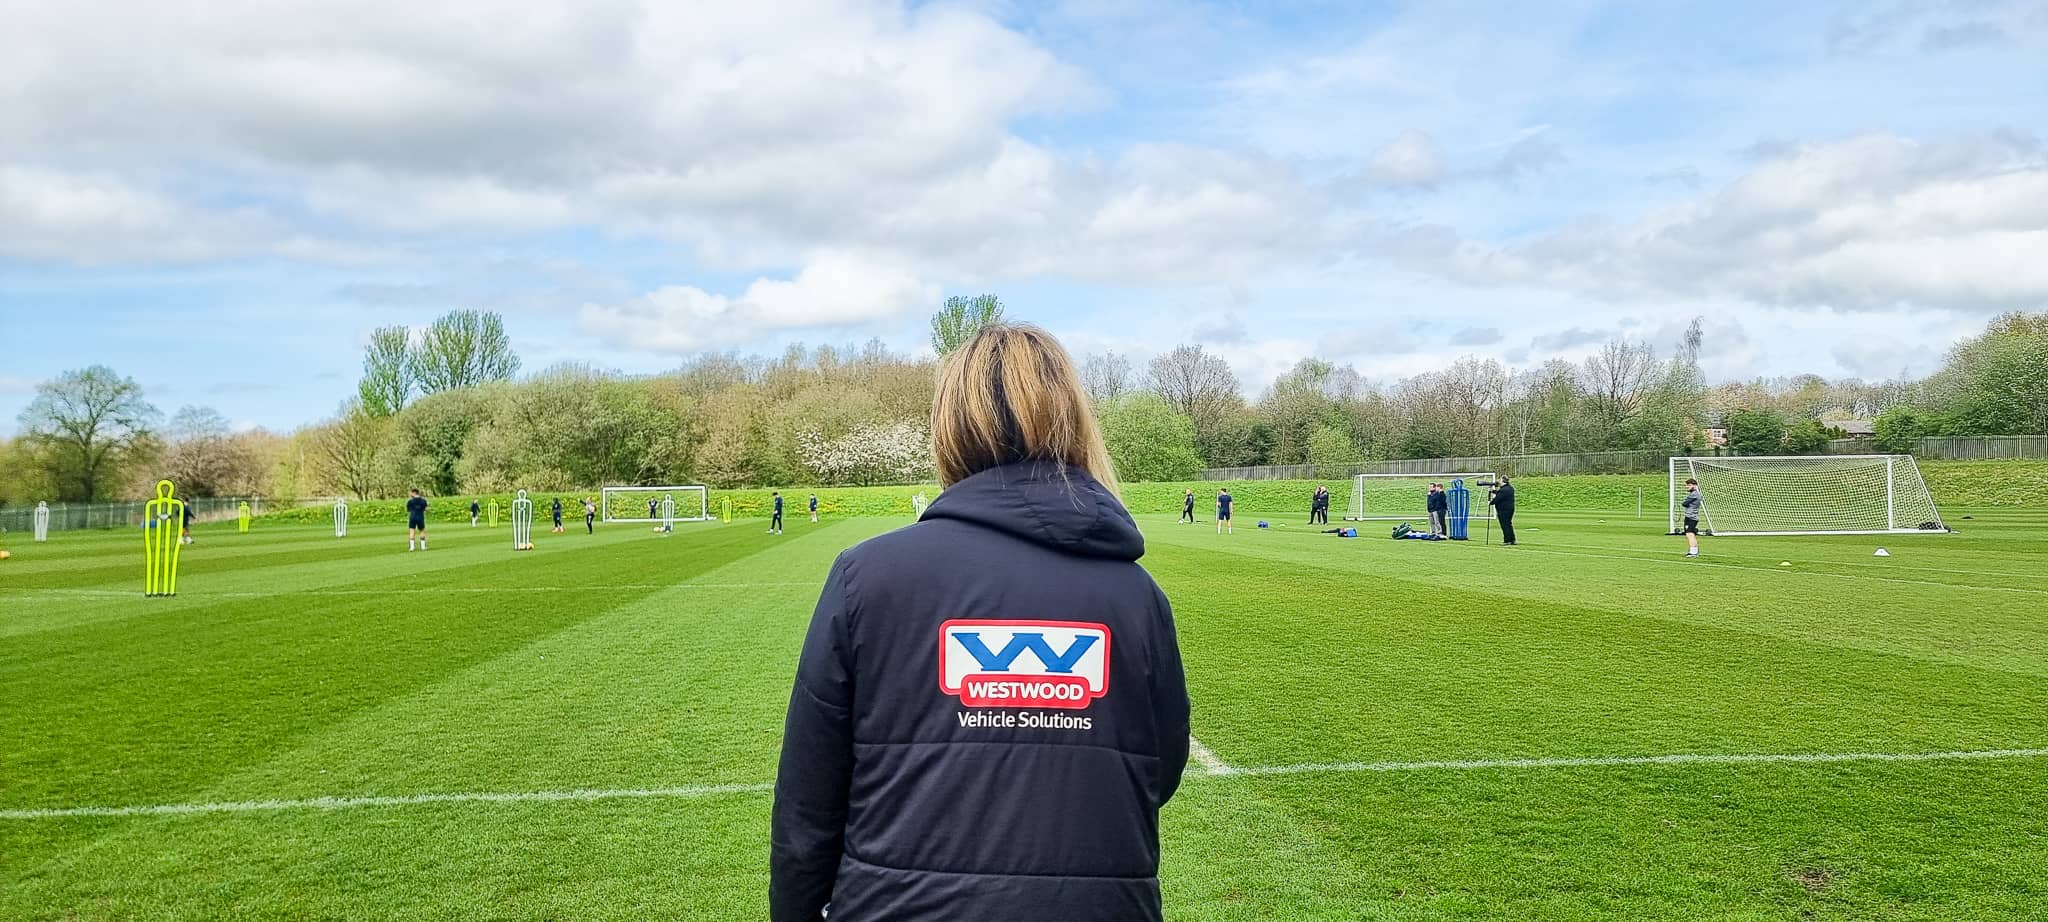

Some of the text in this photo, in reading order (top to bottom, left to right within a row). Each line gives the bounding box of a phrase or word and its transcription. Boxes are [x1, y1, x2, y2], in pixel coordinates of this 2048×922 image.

[967, 681, 1084, 700] WESTWOOD
[957, 711, 1092, 730] Vehicle Solutions
